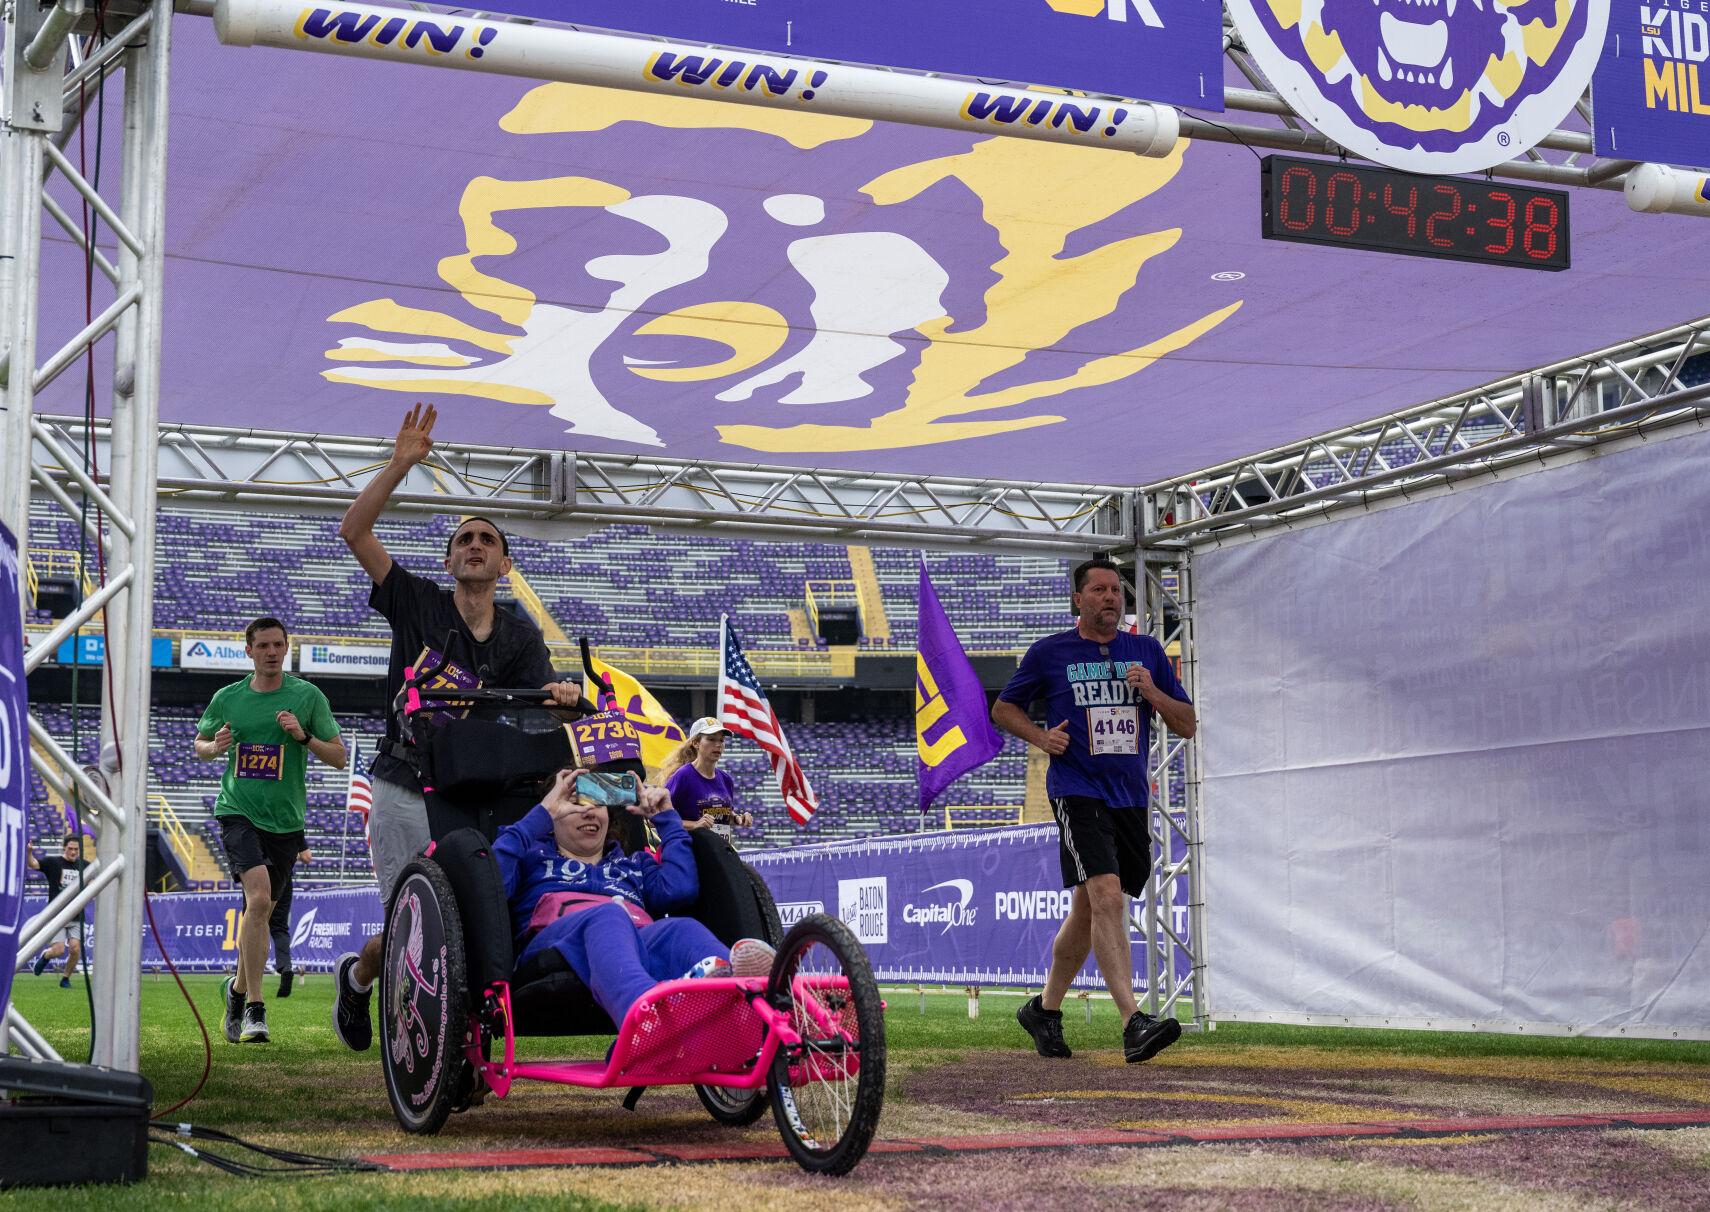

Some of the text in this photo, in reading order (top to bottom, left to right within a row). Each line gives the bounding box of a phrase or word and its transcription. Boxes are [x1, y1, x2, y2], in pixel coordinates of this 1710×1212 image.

[297, 7, 498, 61] WIN!
[1640, 5, 1709, 61] KID
[1641, 25, 1660, 36] LSU
[643, 50, 828, 101] WIN!
[1643, 57, 1710, 116] MIL
[960, 92, 1128, 138] WIN!
[1280, 166, 1558, 260] 00:42:38
[329, 653, 390, 665] Cornerstone
[1066, 661, 1112, 682] GAME
[576, 720, 638, 743] 2736
[1094, 719, 1136, 735] 4146
[241, 753, 277, 770] 1274
[859, 885, 884, 911] BATON
[995, 889, 1075, 920] POWERA
[780, 905, 818, 924] MAR
[859, 912, 884, 937] ROUGE
[175, 924, 225, 937] TIGER
[308, 936, 334, 949] RACING
